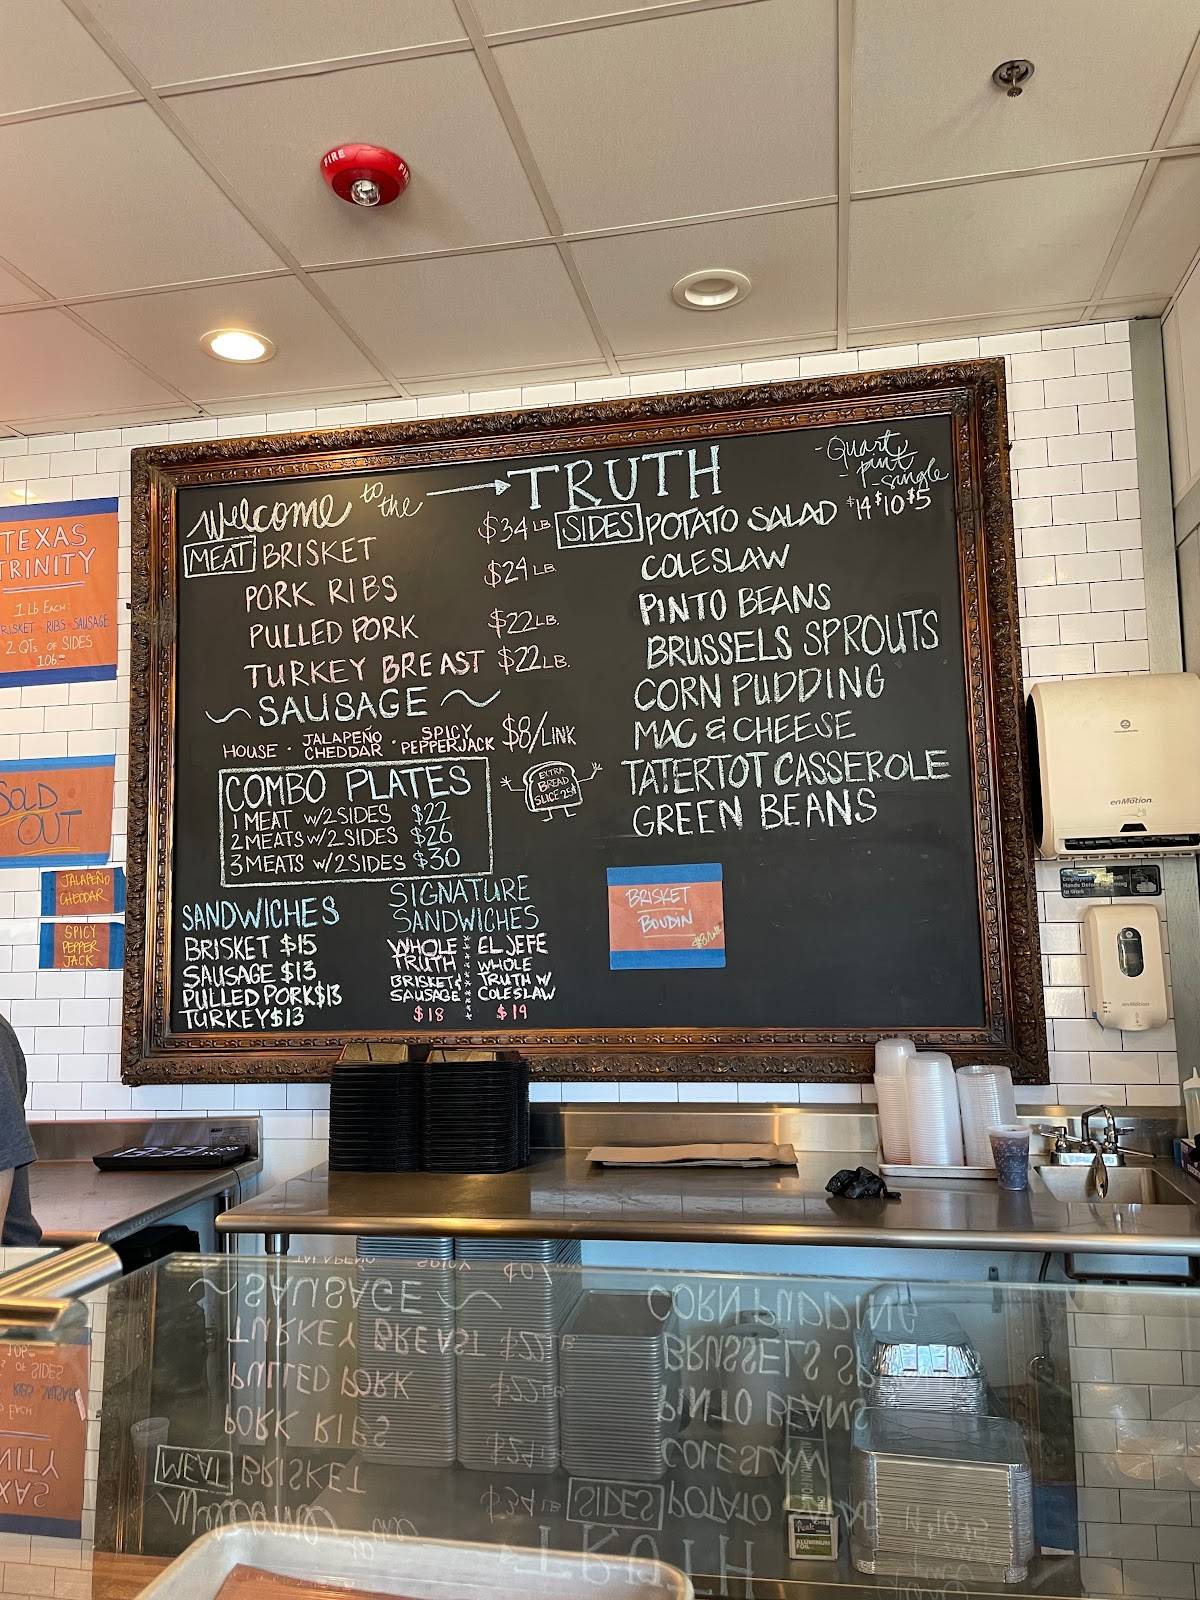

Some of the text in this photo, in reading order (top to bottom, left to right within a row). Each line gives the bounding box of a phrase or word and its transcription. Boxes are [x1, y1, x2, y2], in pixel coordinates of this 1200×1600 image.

[323, 149, 346, 168] FIRE
[187, 445, 722, 540] Welcome to the TRUTH
[846, 487, 932, 520] $14 $10 $5
[561, 509, 635, 543] SIDES
[644, 500, 838, 546] POTATO SALAD
[0, 523, 88, 555] TEXAS
[262, 537, 377, 570] BRISKET
[478, 511, 528, 544] $34
[189, 543, 247, 572] MEAT
[641, 543, 790, 581] COLESLAW
[245, 581, 315, 612] PORK
[330, 575, 398, 605] RIBS
[484, 556, 528, 588] $24
[638, 582, 832, 627] PINTO BEANS
[6, 641, 16, 655] 2
[62, 635, 93, 650] SIDES
[249, 619, 343, 649] PULLED
[352, 614, 419, 644] PORK
[646, 608, 940, 671] BRUSSELS SPROUTS
[244, 657, 366, 690] TURKEY
[382, 650, 486, 685] BREAST
[633, 663, 885, 712] CORN PUDDING
[258, 686, 428, 727] SAUSAGE
[421, 724, 473, 741] SPICY
[634, 709, 856, 751] MAC & CHEESE
[223, 744, 278, 759] HOUSE
[304, 744, 383, 761] CHEDDAR
[537, 777, 569, 793] BREAD
[538, 767, 565, 780] EXTRA
[620, 749, 952, 797] TATERTOT CASSEROLE
[0, 780, 58, 817] SOLD
[225, 765, 472, 812] COMBO PLATES
[534, 791, 560, 806] SLICE
[232, 813, 238, 830] 1
[244, 809, 292, 832] MEAT
[342, 803, 392, 826] SIDES
[411, 800, 451, 826] $22
[632, 787, 879, 837] GREEN BEANS
[18, 809, 83, 846] OUT
[230, 833, 243, 851] 2
[245, 830, 304, 850] MEATS
[344, 826, 398, 847] SIDES
[410, 823, 453, 848] $26
[230, 854, 243, 877] 3
[245, 853, 304, 875] MEATS
[349, 850, 406, 873] SIDES
[412, 847, 461, 871] $30
[388, 874, 531, 908] SIGNATURE
[625, 886, 691, 908] BRISKET
[182, 895, 340, 932] SANDWICHES
[392, 904, 540, 934] SANDWICHES
[62, 940, 101, 954] PEPPER
[64, 925, 97, 940] SPICY
[184, 932, 318, 962] BRISKET $15
[386, 936, 458, 957] WHOLE
[478, 932, 549, 956] EL JEFE
[63, 955, 95, 968] JACK
[183, 959, 317, 989] SAUSAGE $13
[391, 951, 457, 973] TRUTH
[477, 957, 533, 972] WHOLE
[477, 971, 531, 987] TRUTH
[478, 985, 556, 1001] COLESLAW
[183, 987, 260, 1011] PULLED
[390, 989, 461, 1003] SAUSAGE
